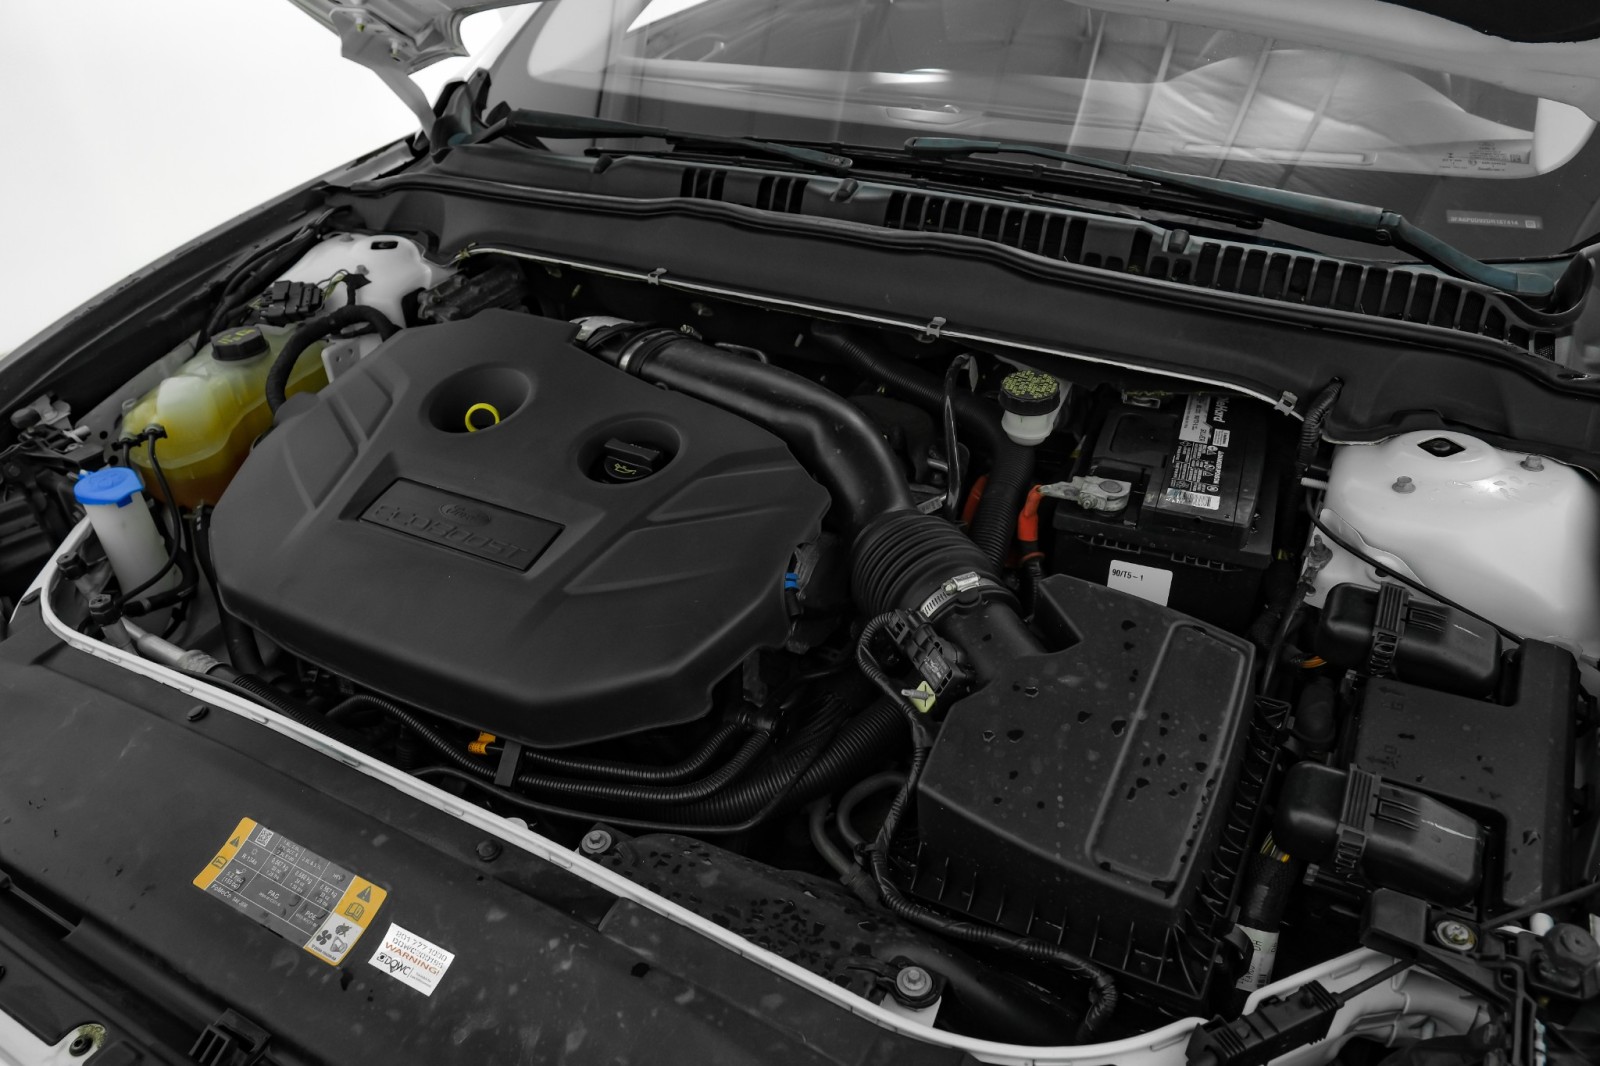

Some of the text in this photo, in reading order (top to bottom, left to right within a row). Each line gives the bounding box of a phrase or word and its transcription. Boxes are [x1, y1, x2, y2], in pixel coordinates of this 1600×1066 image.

[211, 883, 232, 898] FoMoCo
[267, 889, 280, 899] PAG
[385, 941, 440, 976] WARNING!
